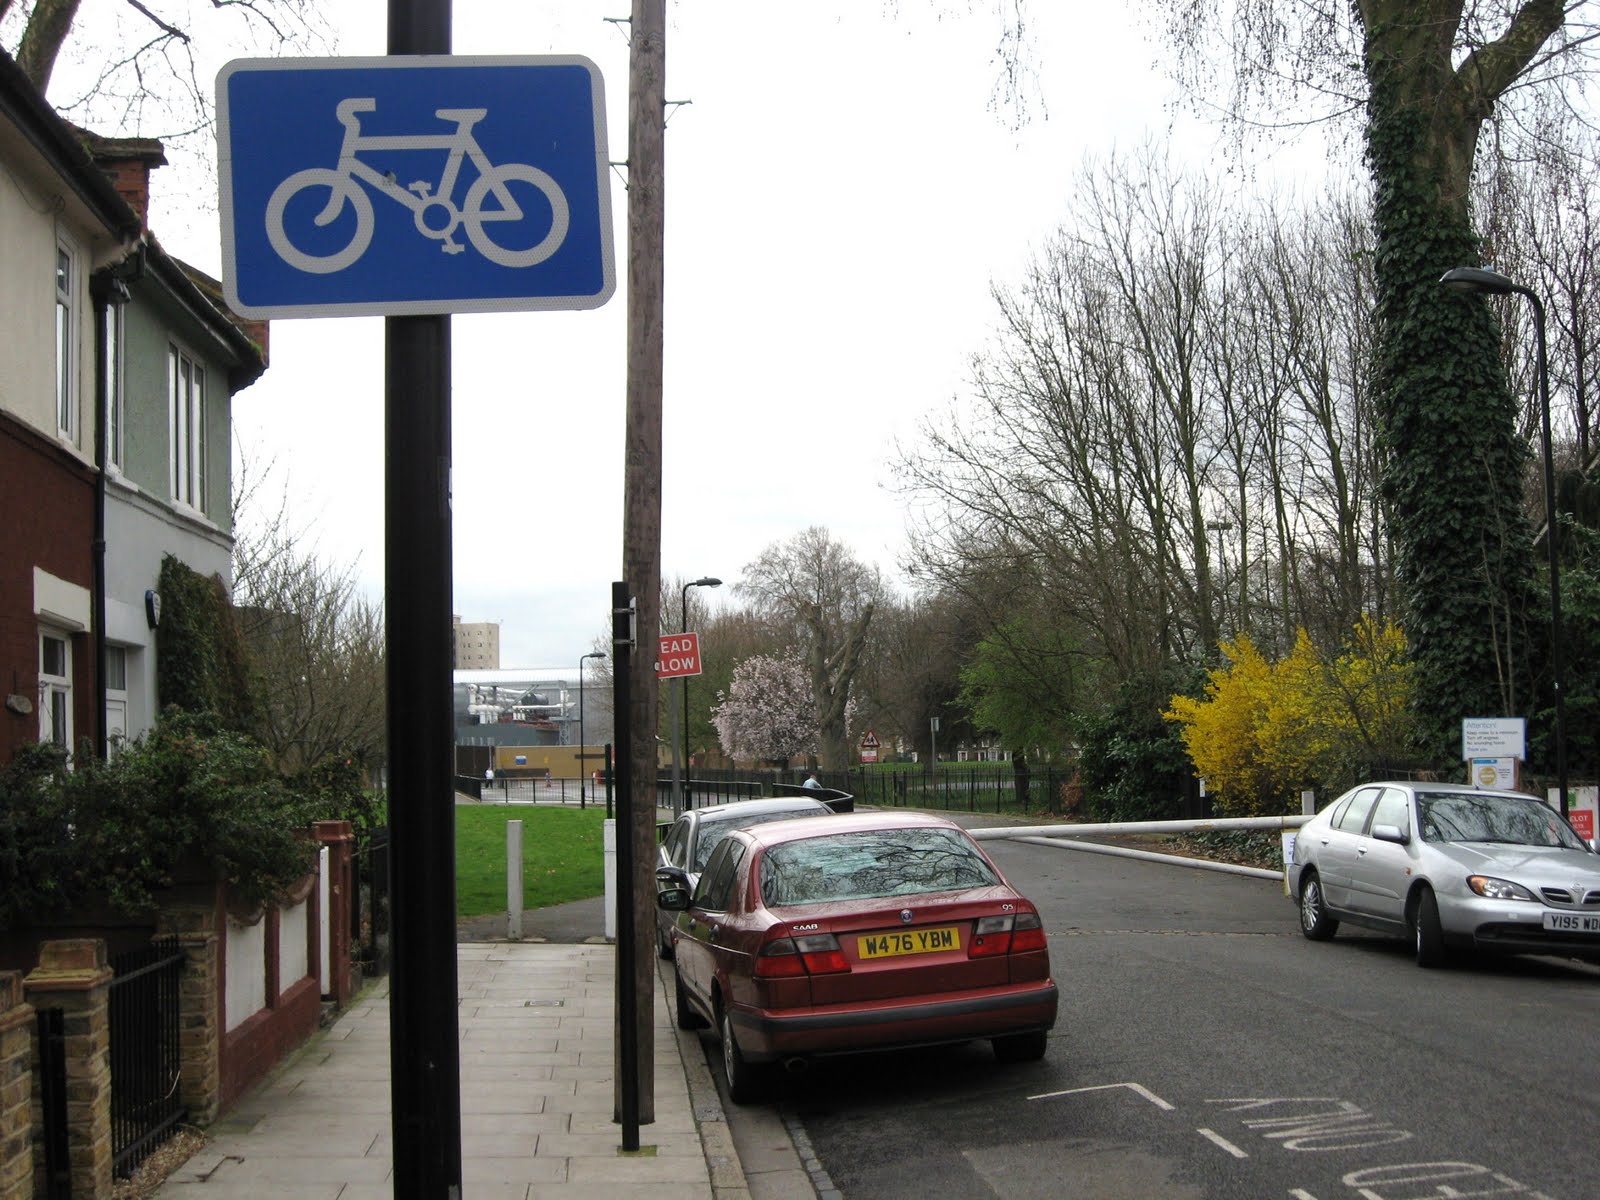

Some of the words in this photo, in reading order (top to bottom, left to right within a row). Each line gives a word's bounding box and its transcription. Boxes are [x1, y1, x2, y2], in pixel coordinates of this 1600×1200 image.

[792, 923, 819, 931] SAAB
[1583, 918, 1600, 930] ND
[866, 934, 914, 955] W476
[917, 929, 953, 949] YBM
